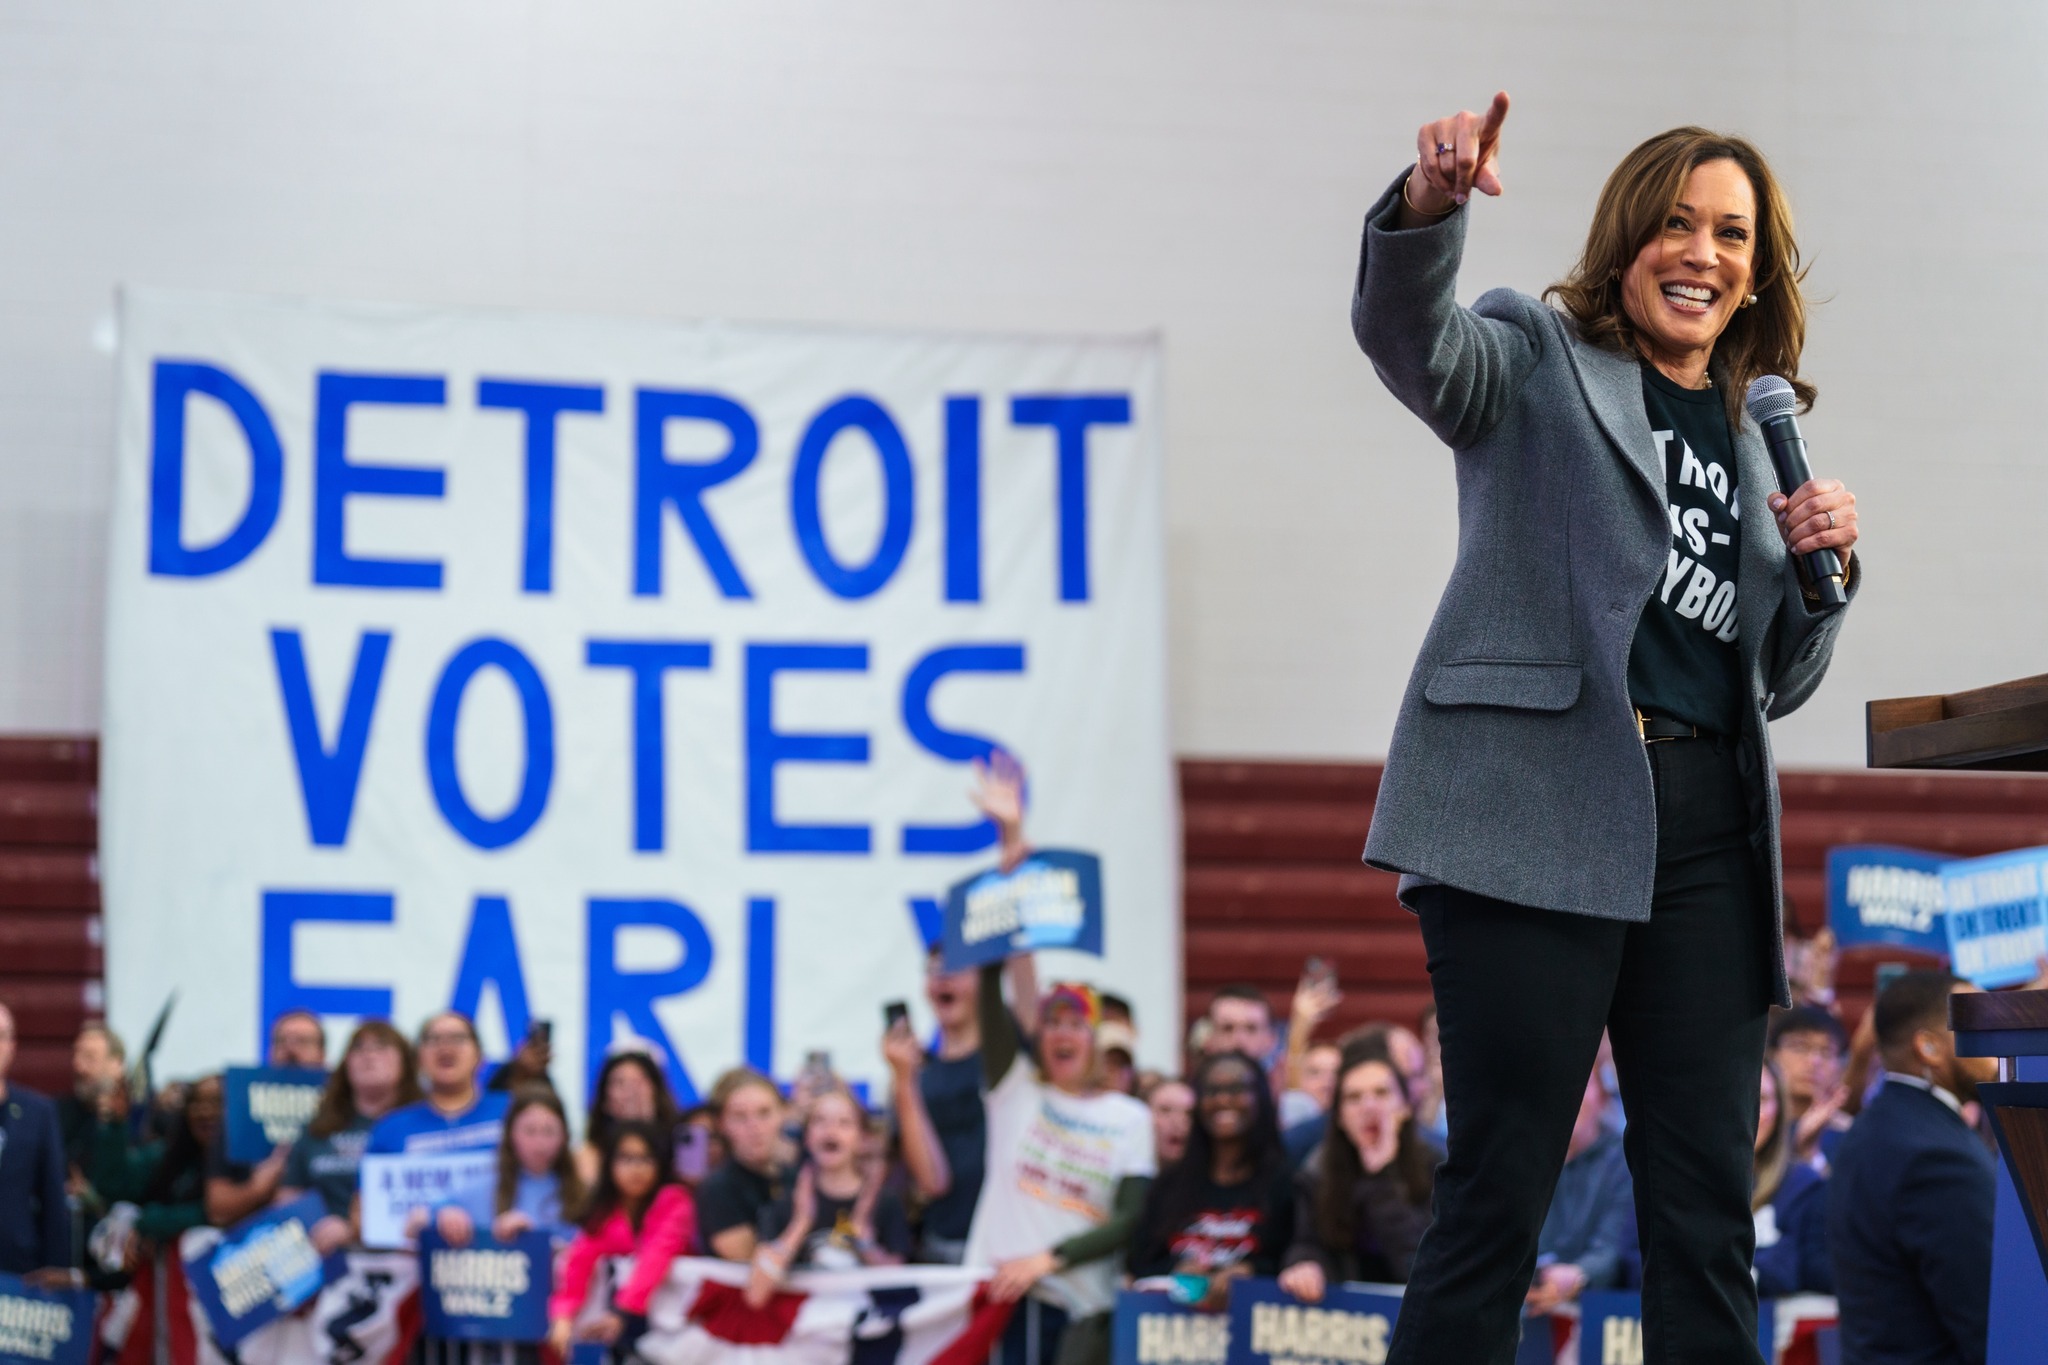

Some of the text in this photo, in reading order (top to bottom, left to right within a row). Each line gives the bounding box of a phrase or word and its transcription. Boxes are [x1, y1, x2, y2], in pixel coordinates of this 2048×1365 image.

[147, 359, 1132, 605] DETROIT
[268, 627, 1029, 856] VOTES
[1846, 865, 1947, 914] HARRIS
[430, 1250, 530, 1294] HARRIS
[0, 1294, 73, 1343] ARRIS
[441, 1293, 513, 1318] WALZ
[1251, 1302, 1391, 1362] HARRIS
